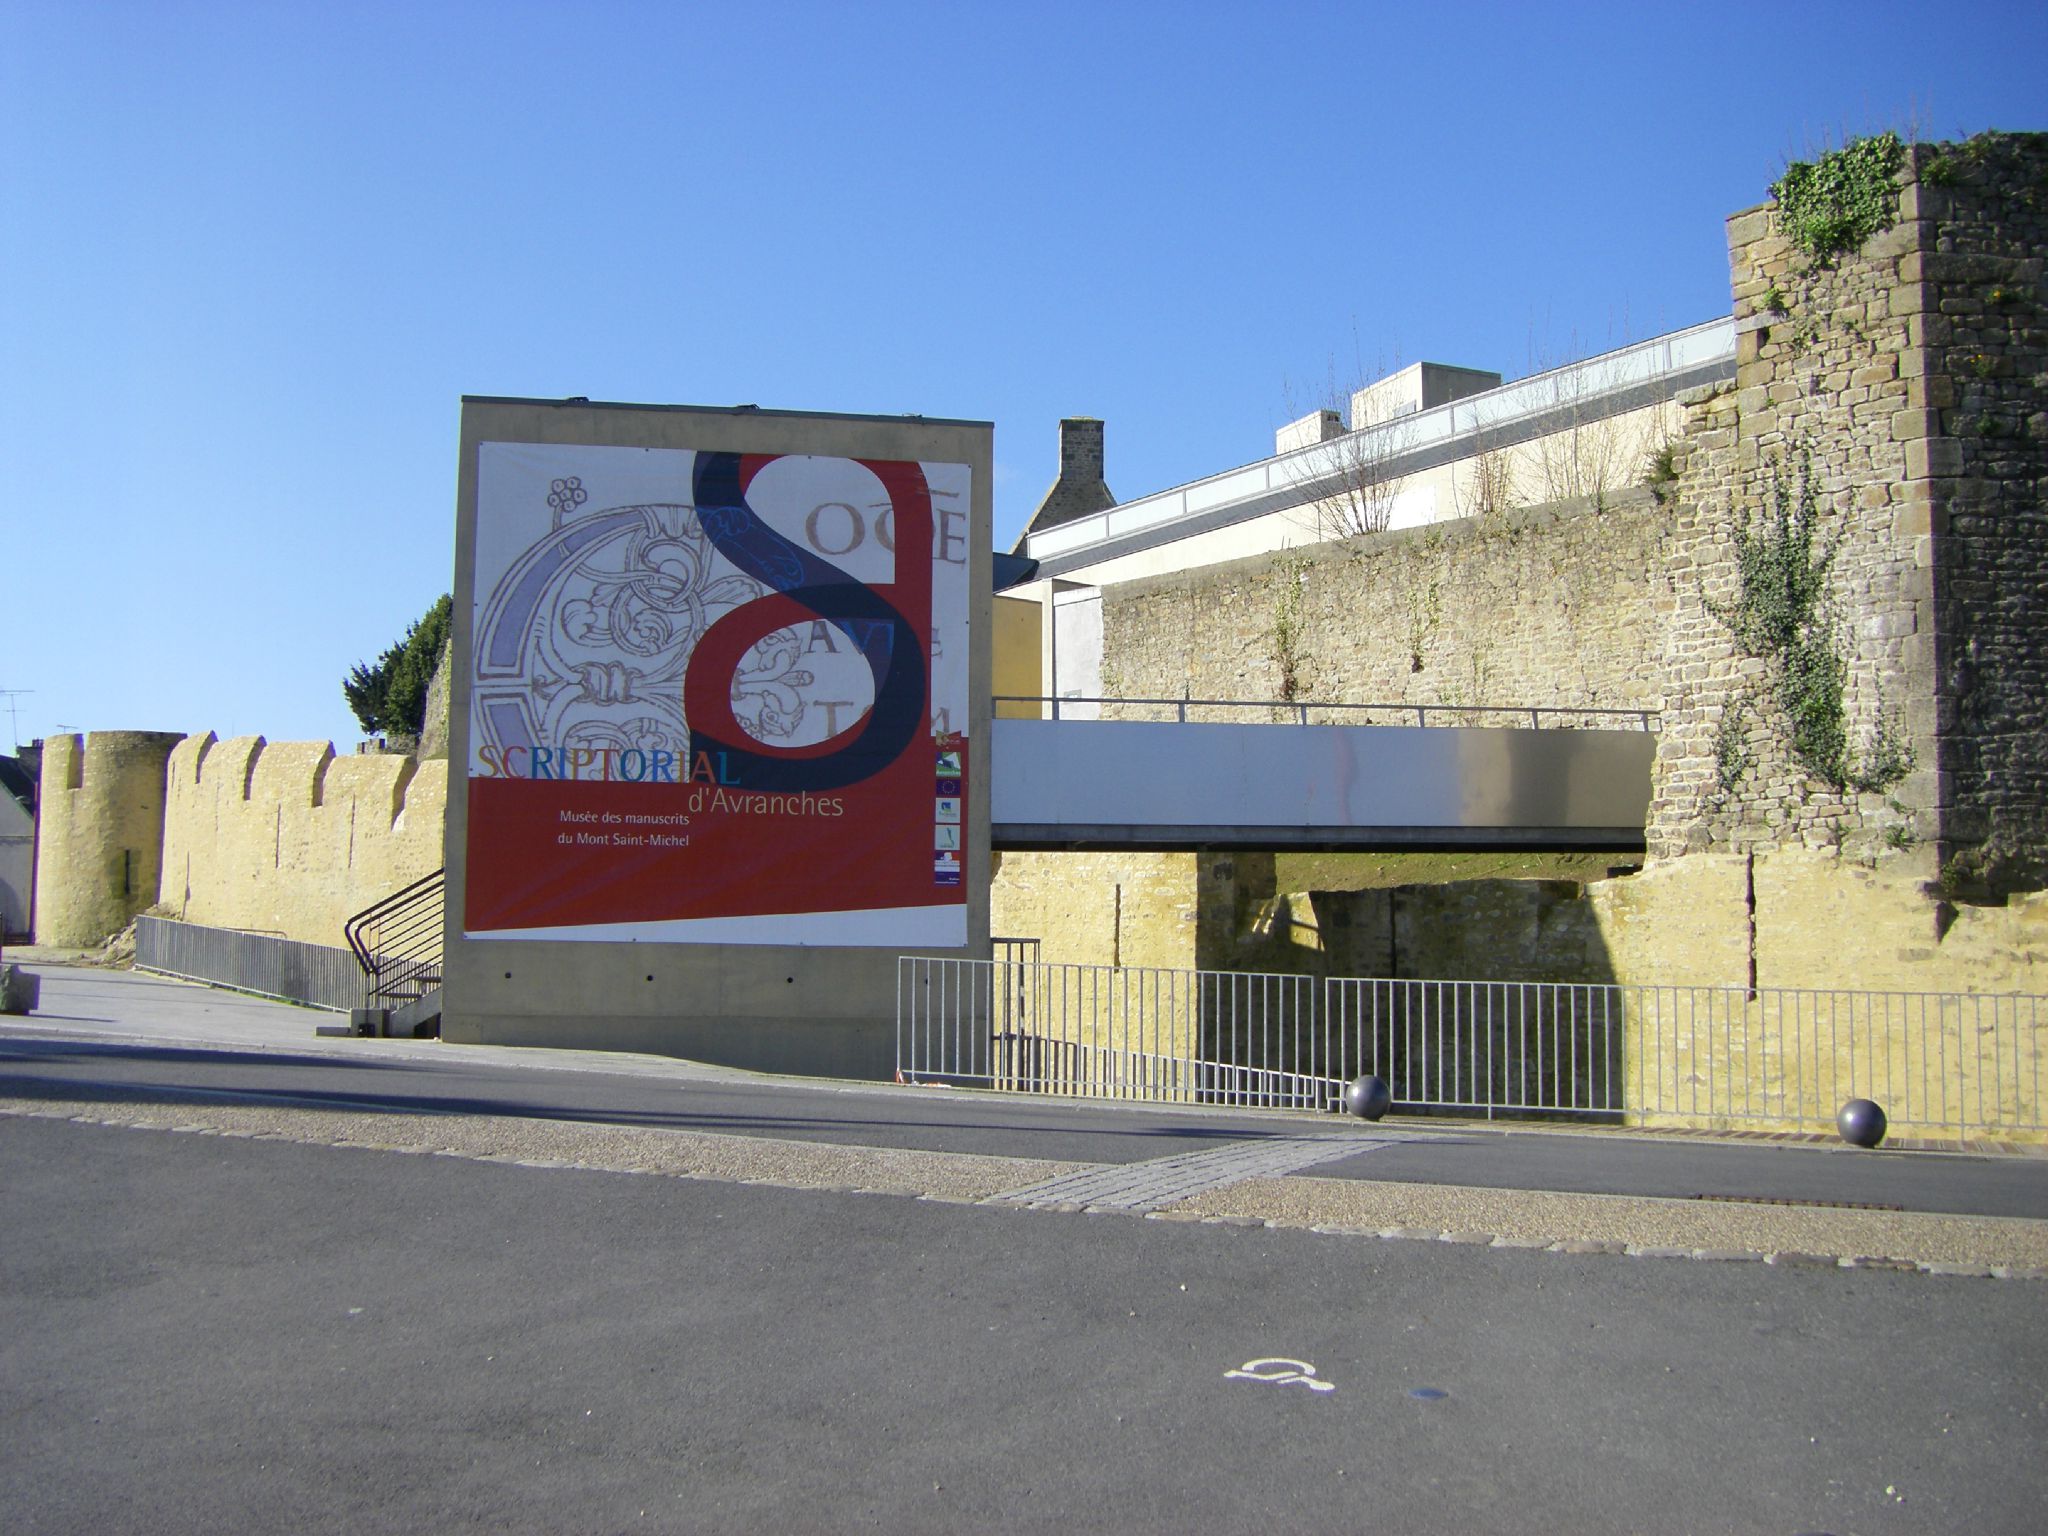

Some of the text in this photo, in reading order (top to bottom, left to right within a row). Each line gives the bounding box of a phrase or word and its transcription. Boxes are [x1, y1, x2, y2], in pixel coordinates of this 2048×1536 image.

[477, 744, 741, 785] SCRIPTORIAL
[687, 787, 845, 817] d'Avranches
[559, 809, 690, 825] Musée des manuscrits
[557, 832, 690, 847] du Mont Saint-Michel
